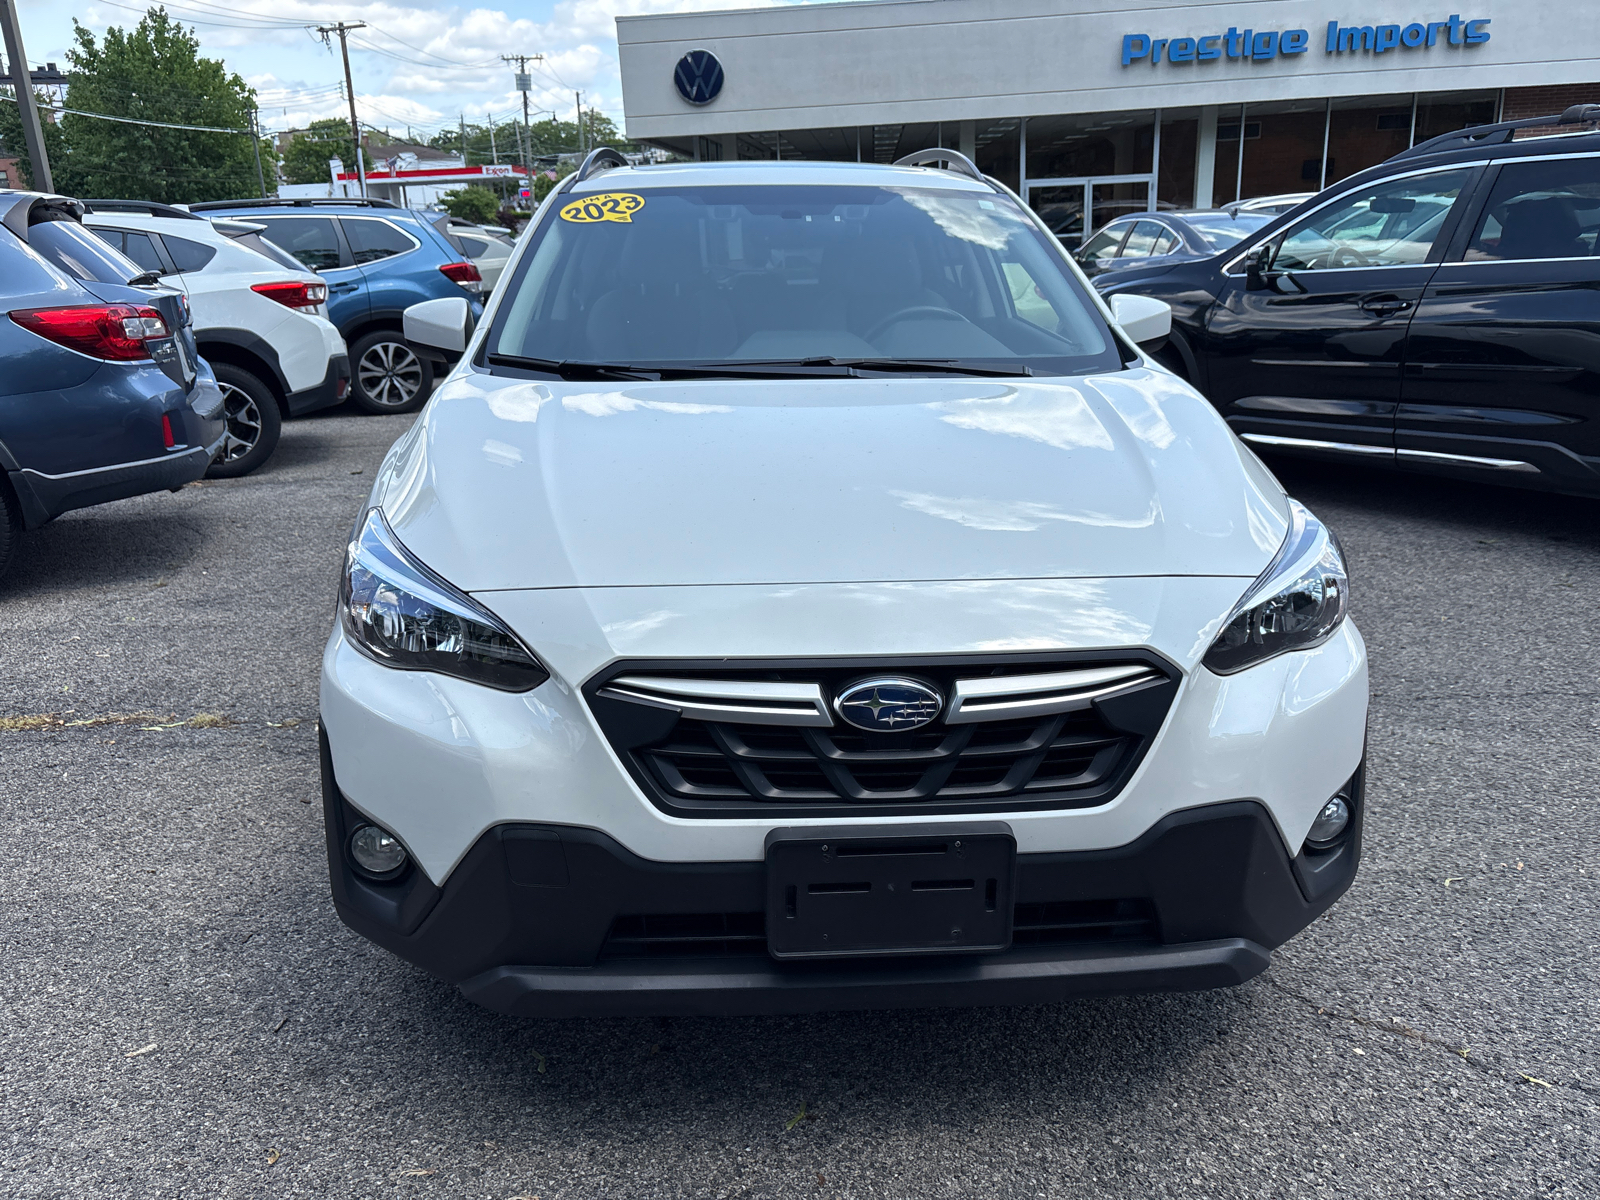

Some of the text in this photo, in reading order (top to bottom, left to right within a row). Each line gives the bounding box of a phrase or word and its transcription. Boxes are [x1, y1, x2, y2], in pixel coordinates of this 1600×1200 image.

[1121, 14, 1492, 65] Prestige Imports
[485, 167, 510, 176] Exxon
[564, 196, 642, 220] 2023
[582, 196, 600, 204] I'M
